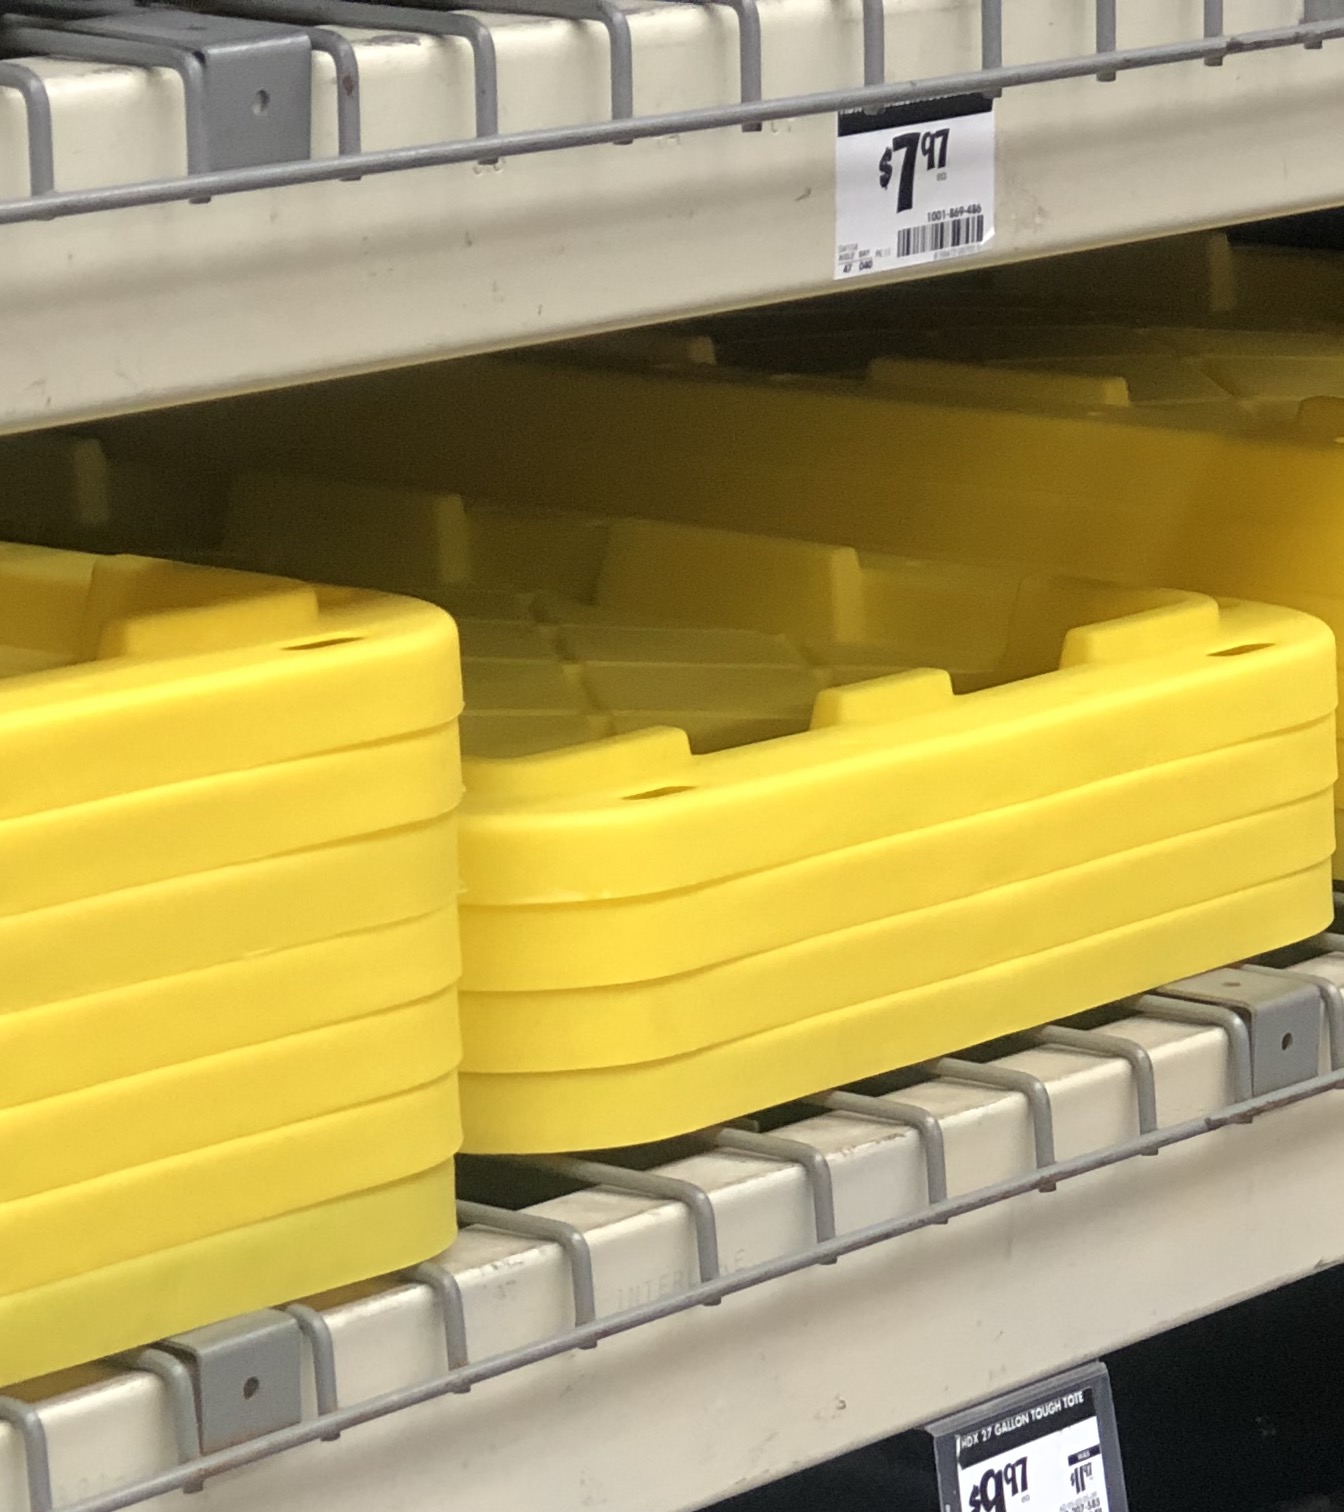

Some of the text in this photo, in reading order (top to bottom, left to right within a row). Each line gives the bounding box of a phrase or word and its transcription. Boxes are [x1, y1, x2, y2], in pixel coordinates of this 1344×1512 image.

[961, 1391, 1085, 1450] HDX 27 GALLON TOUGH TOTE
